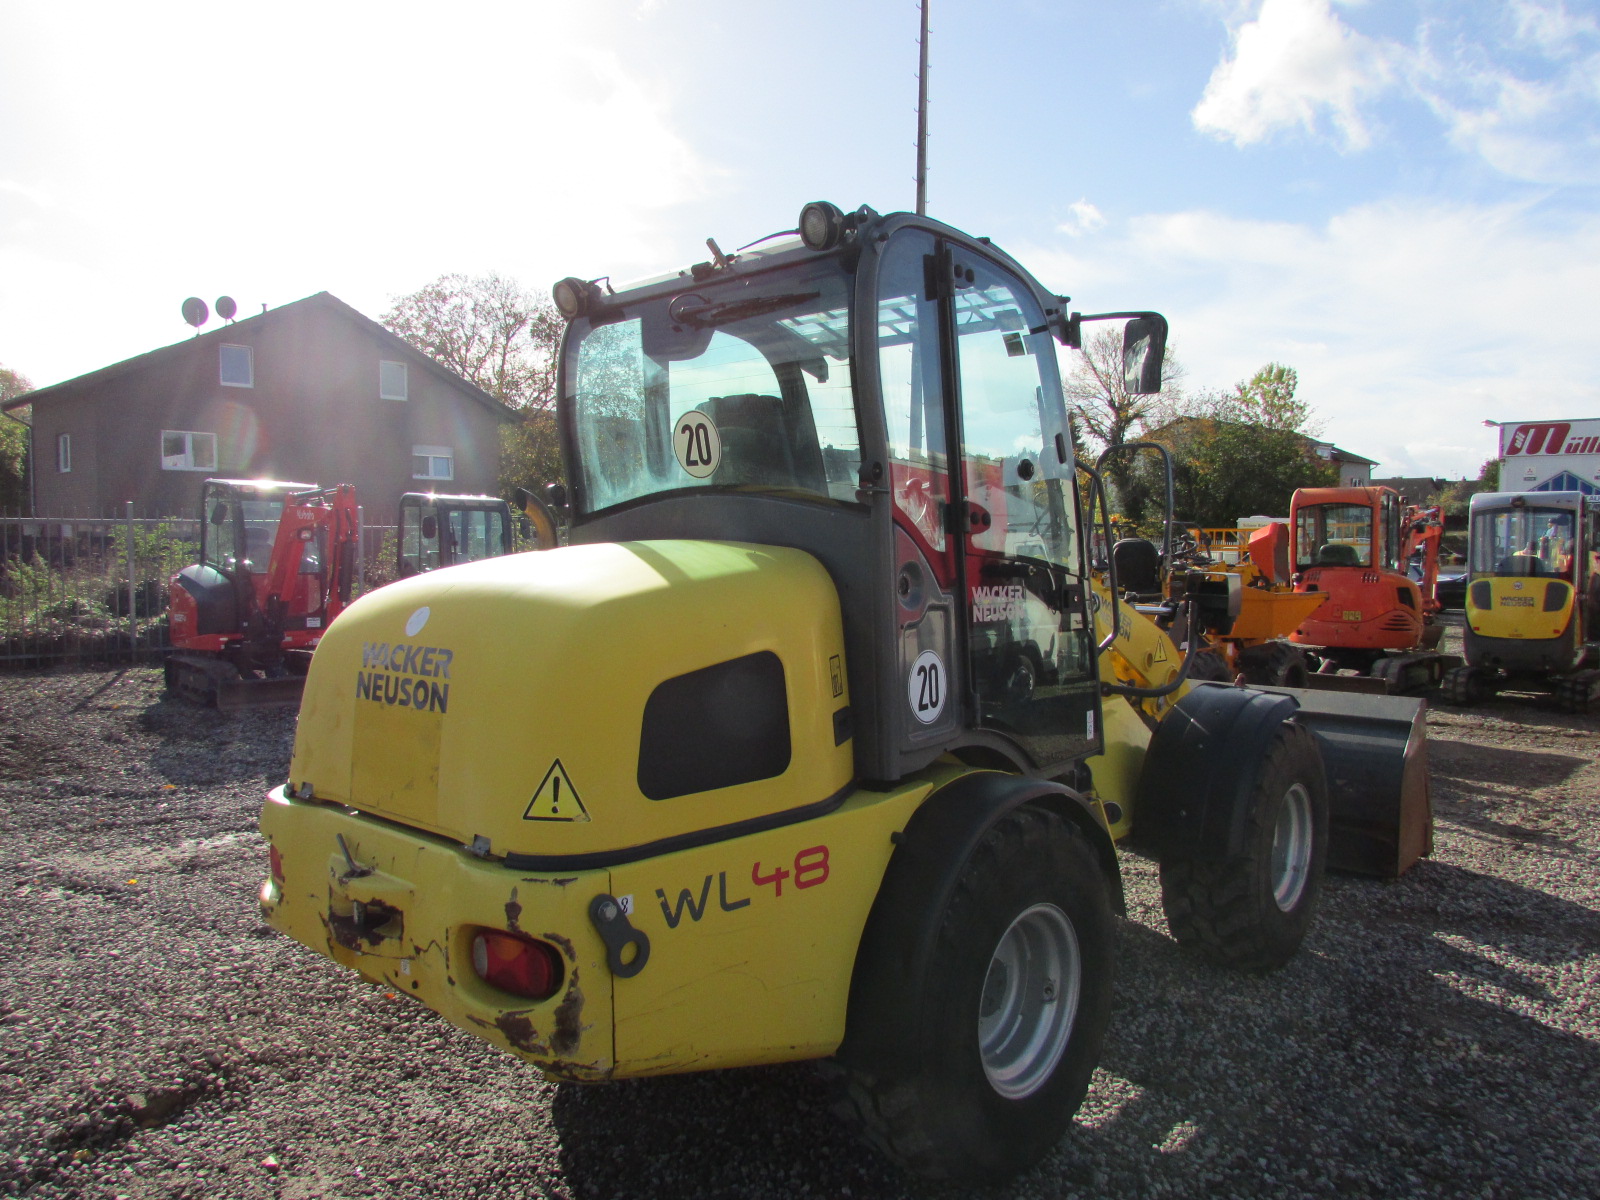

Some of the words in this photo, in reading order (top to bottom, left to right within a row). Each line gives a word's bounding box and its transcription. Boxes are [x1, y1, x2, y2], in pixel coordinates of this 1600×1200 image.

[681, 423, 712, 466] 20
[972, 586, 1023, 603] WACKER
[973, 604, 1025, 622] NEUSON
[362, 641, 455, 679] WACKER
[356, 671, 450, 713] NEUSON
[917, 663, 940, 712] 20
